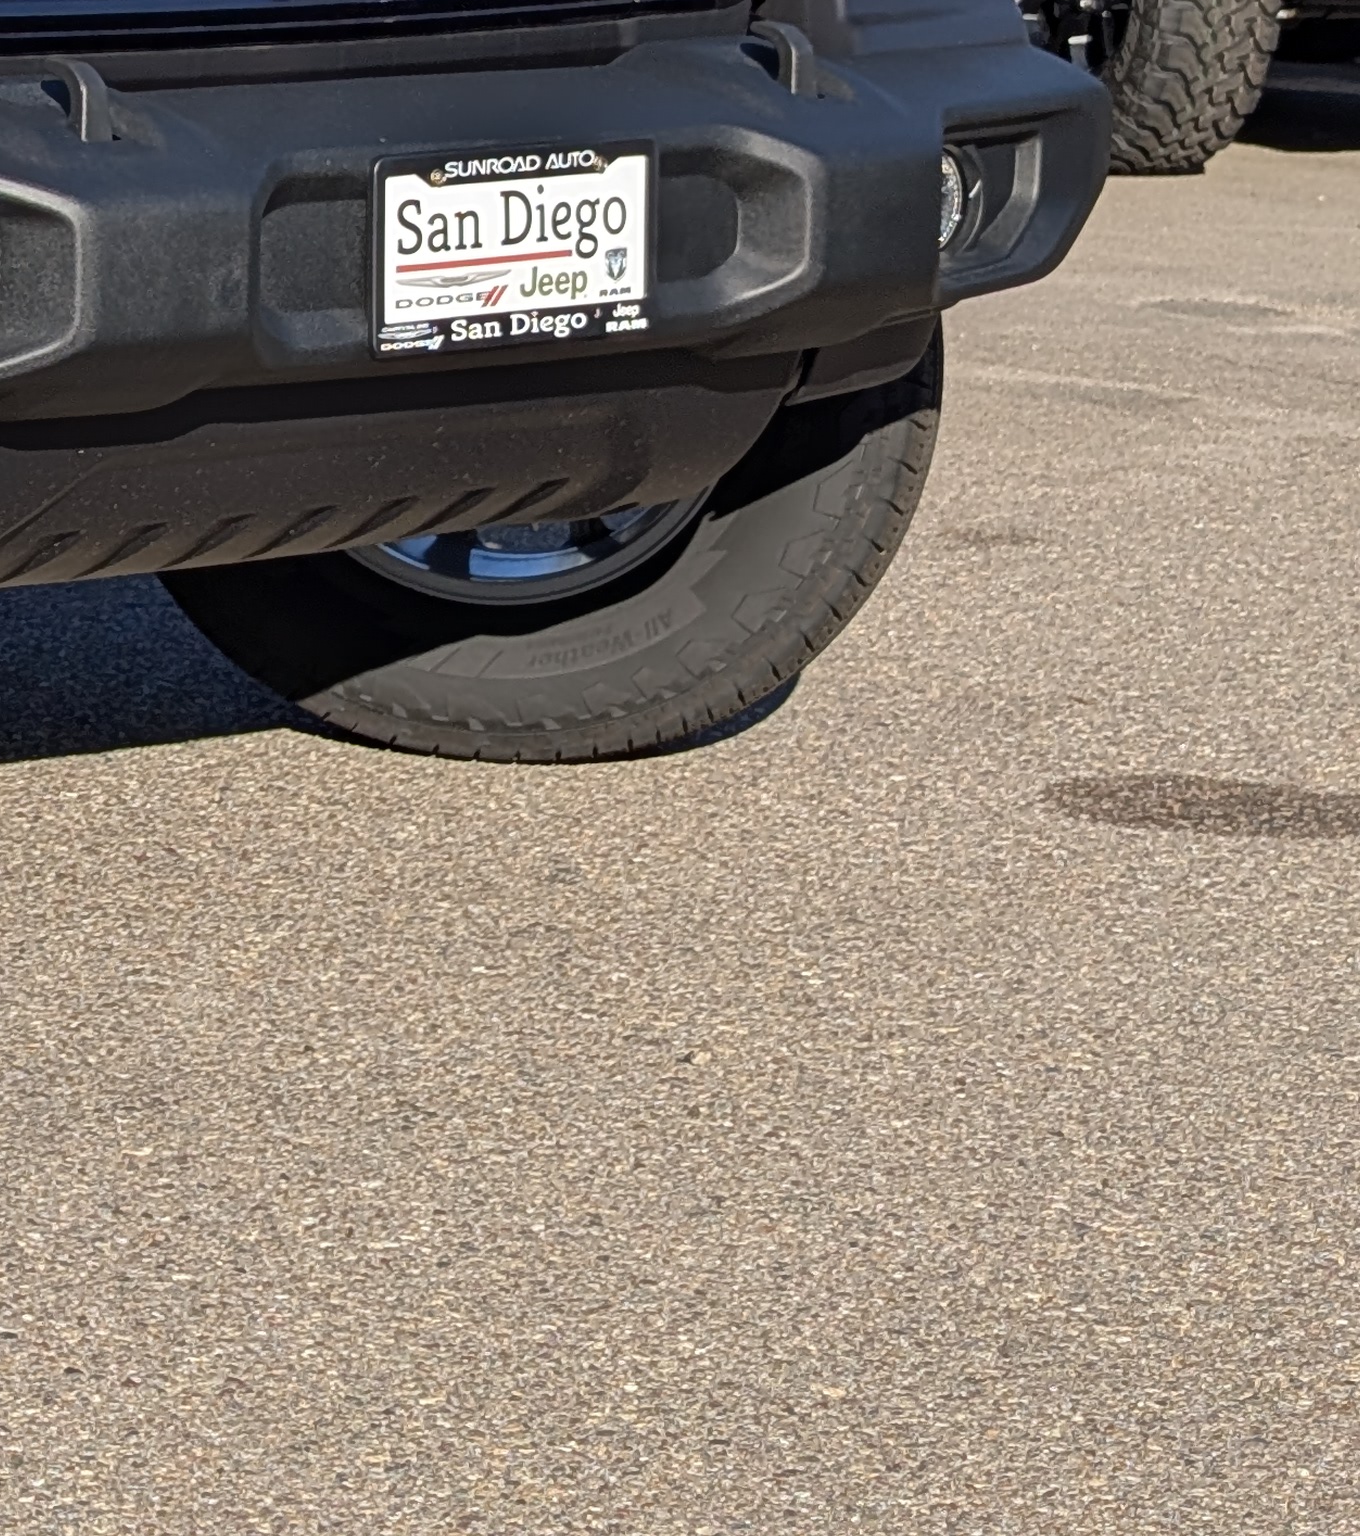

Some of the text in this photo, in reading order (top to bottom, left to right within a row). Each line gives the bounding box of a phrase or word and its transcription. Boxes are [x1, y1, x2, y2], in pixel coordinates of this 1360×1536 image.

[444, 149, 595, 178] SUNROAD AUTO
[397, 184, 627, 259] San Diego
[520, 266, 588, 300] Jeep
[599, 286, 632, 297] RAM
[395, 291, 490, 309] DODGE
[451, 319, 502, 341] San
[509, 311, 588, 338] Diego
[606, 318, 648, 333] RAM
